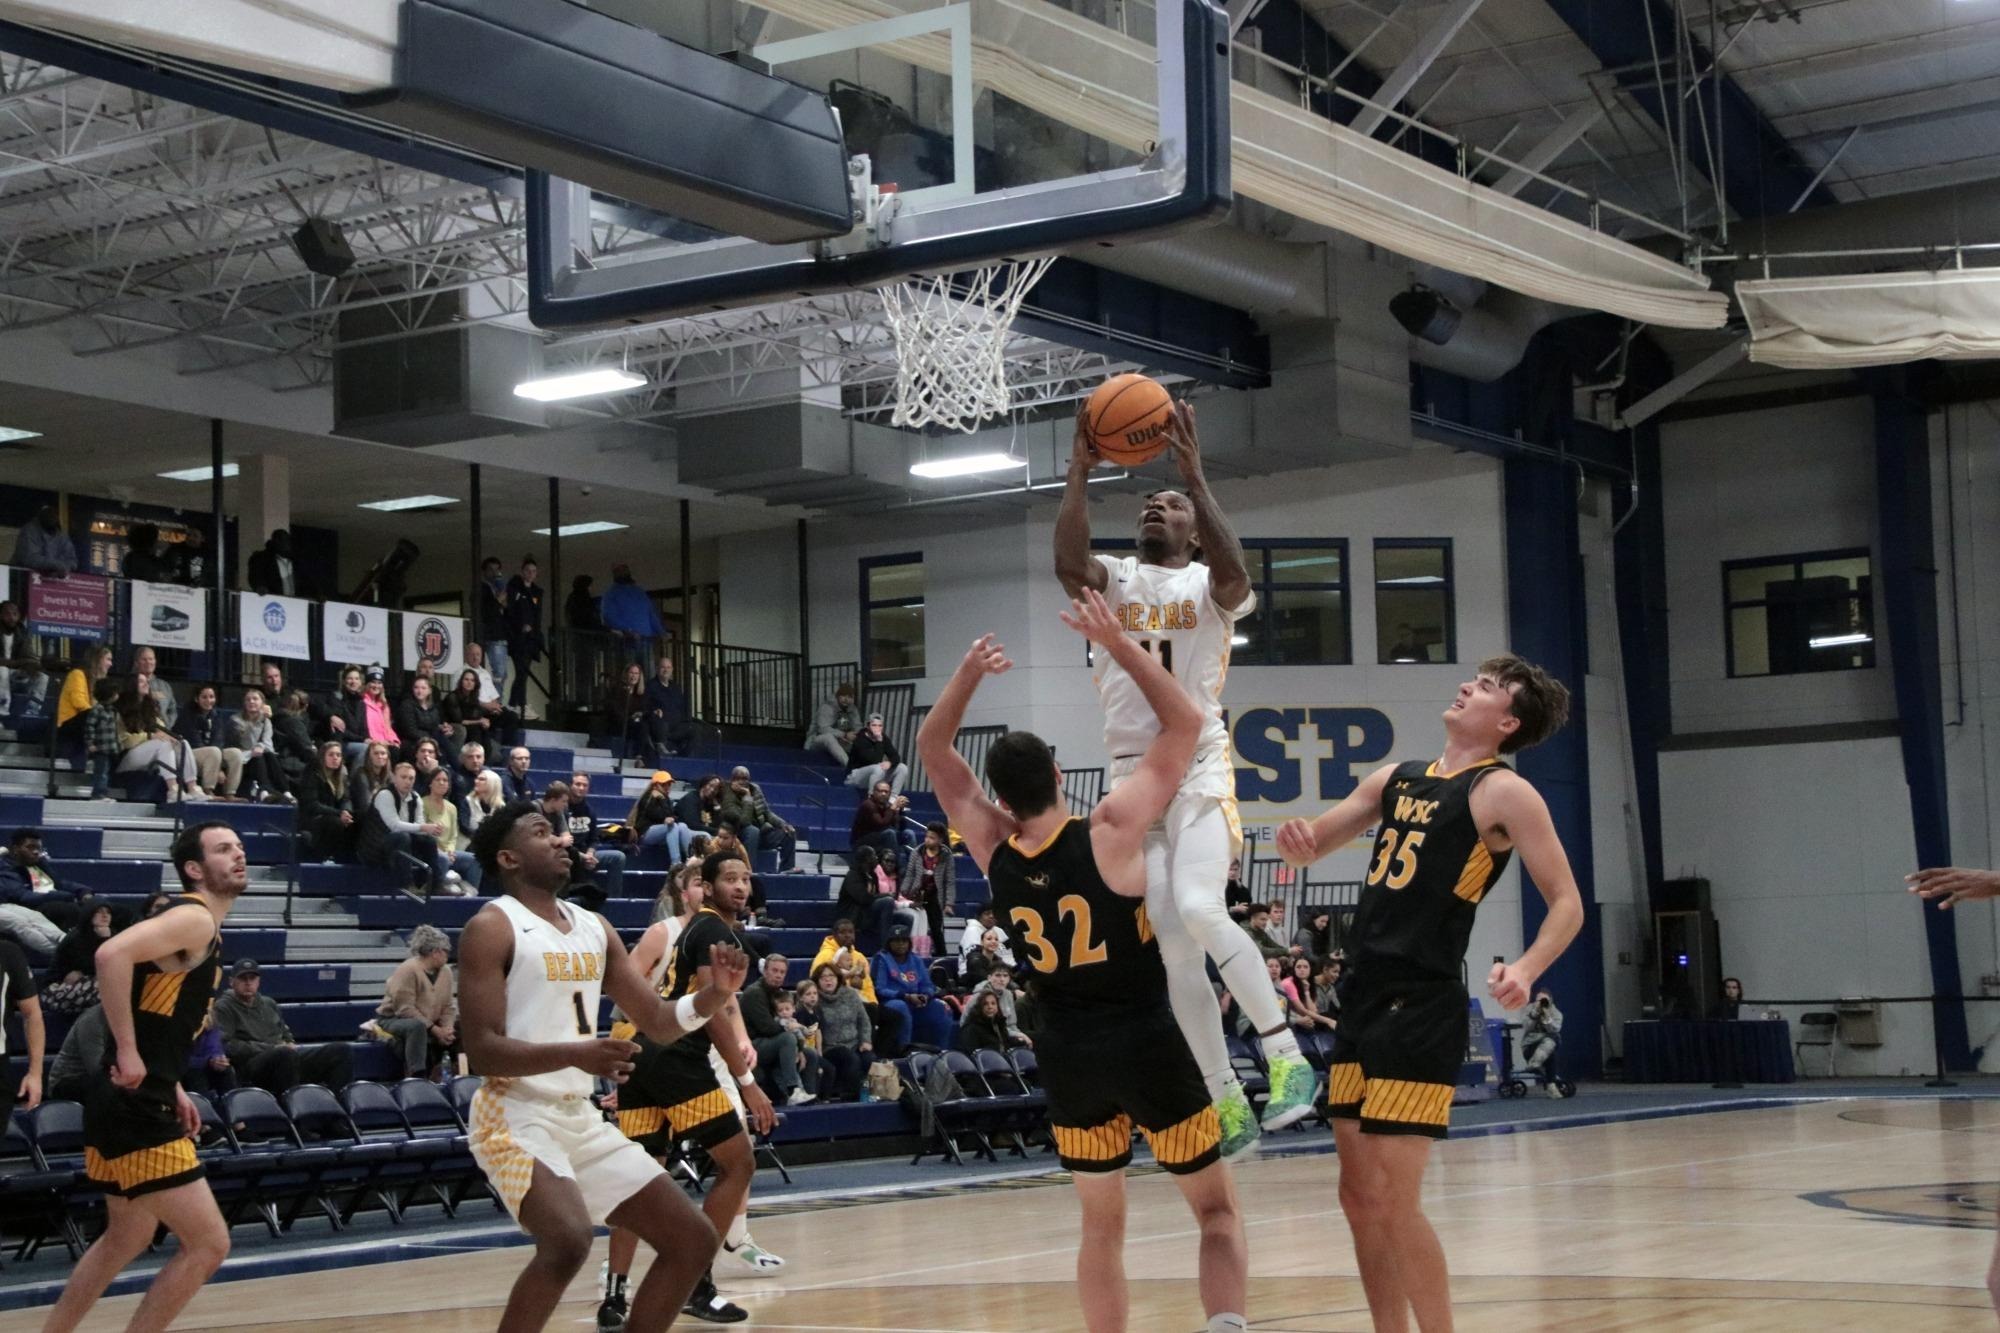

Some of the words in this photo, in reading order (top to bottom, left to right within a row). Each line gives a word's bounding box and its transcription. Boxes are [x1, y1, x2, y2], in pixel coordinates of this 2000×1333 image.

[1125, 421, 1170, 447] Wilso
[37, 606, 73, 620] Church's
[74, 611, 100, 623] Future
[43, 593, 68, 606] Invest
[70, 597, 78, 607] In
[80, 597, 95, 609] The
[244, 637, 268, 650] ACR
[271, 640, 307, 654] Homes
[1140, 639, 1172, 674] 1
[1221, 707, 1395, 804] SP
[1394, 795, 1440, 824] WSC
[1367, 827, 1426, 890] 35
[1009, 894, 1108, 974] 32
[573, 991, 592, 1034] 1
